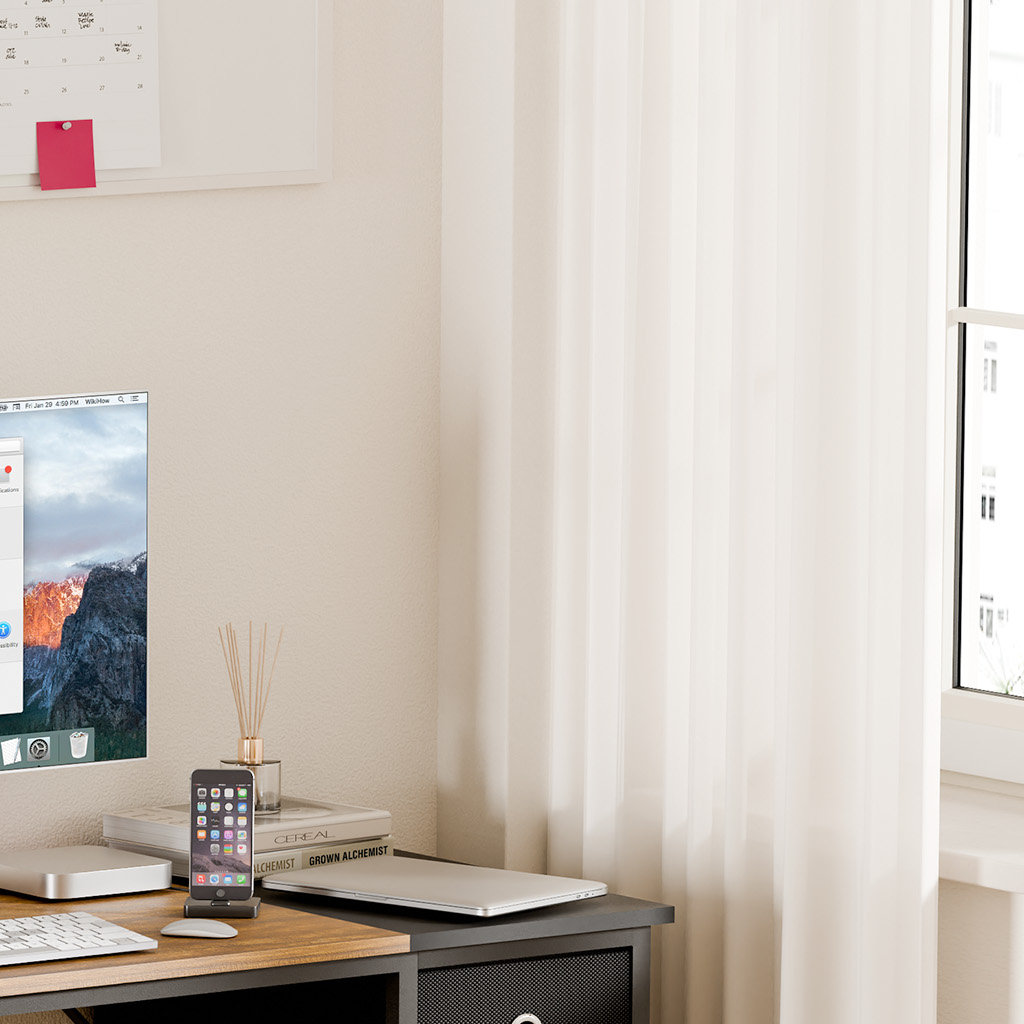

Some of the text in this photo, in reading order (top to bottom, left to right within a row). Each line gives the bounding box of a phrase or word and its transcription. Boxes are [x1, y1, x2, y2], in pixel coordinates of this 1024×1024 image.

[274, 830, 336, 844] CEREAL
[309, 845, 389, 867] GROWN ALCHEMIST
